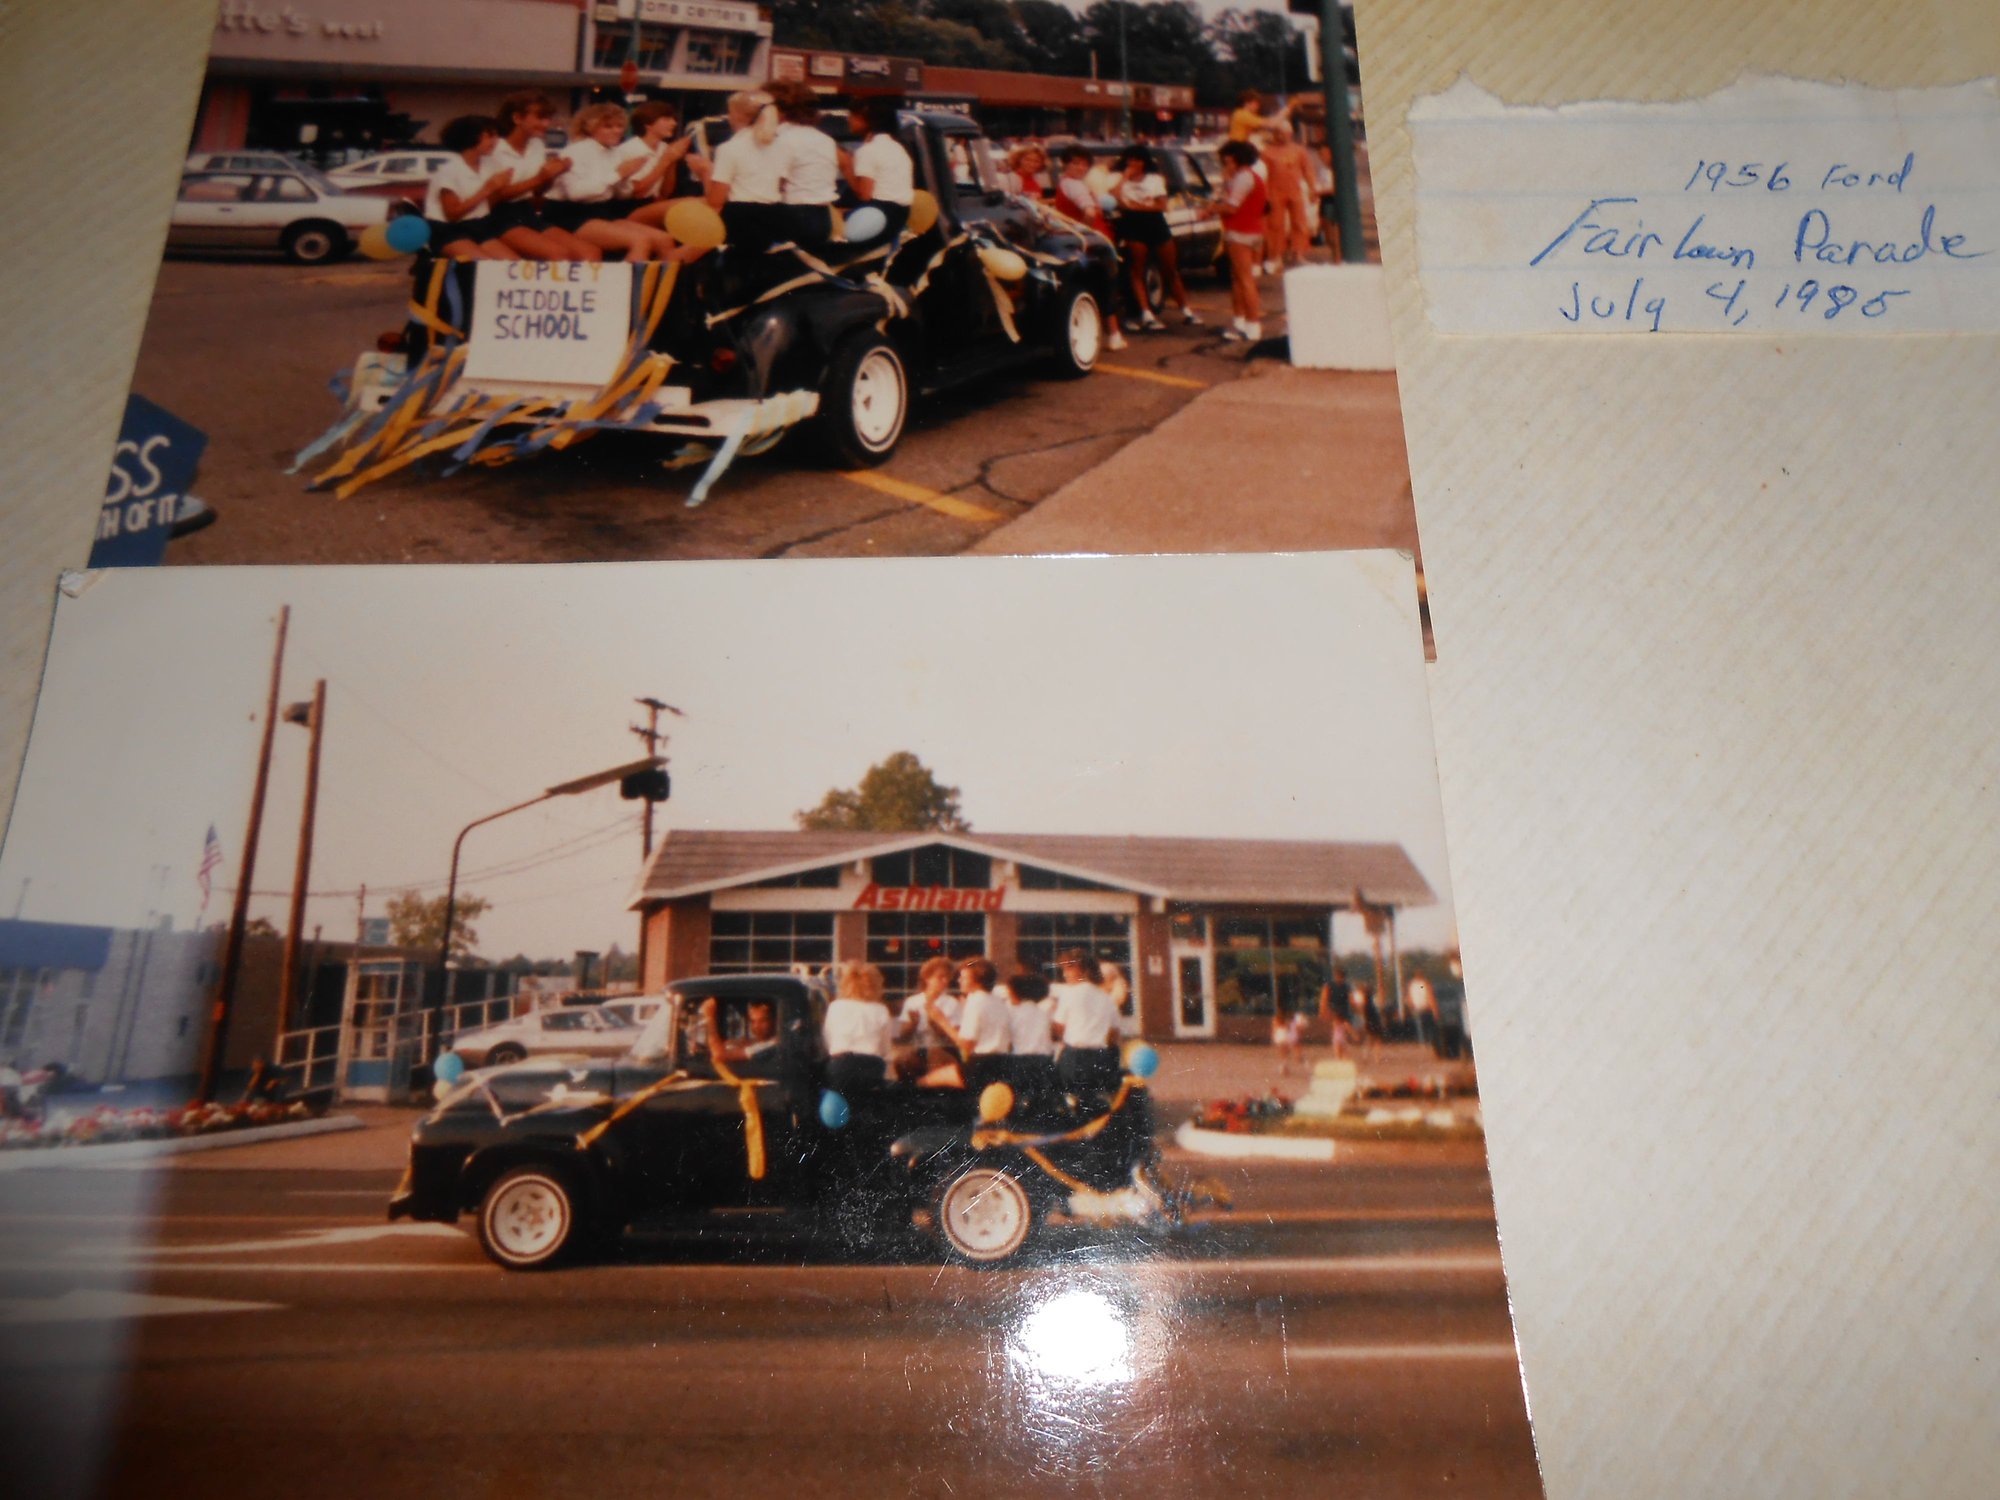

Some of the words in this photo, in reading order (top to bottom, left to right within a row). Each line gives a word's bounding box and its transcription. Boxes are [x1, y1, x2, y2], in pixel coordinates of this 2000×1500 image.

[1684, 160, 1791, 192] 1956
[1821, 152, 1914, 192] Ford
[1794, 204, 1996, 265] Parade
[508, 261, 603, 281] COPLEY
[496, 289, 598, 312] MIDDLE
[1558, 277, 1666, 332] July
[1705, 279, 1749, 326] 4,
[494, 313, 588, 340] SCHOOL
[852, 882, 1007, 911] Ashland
